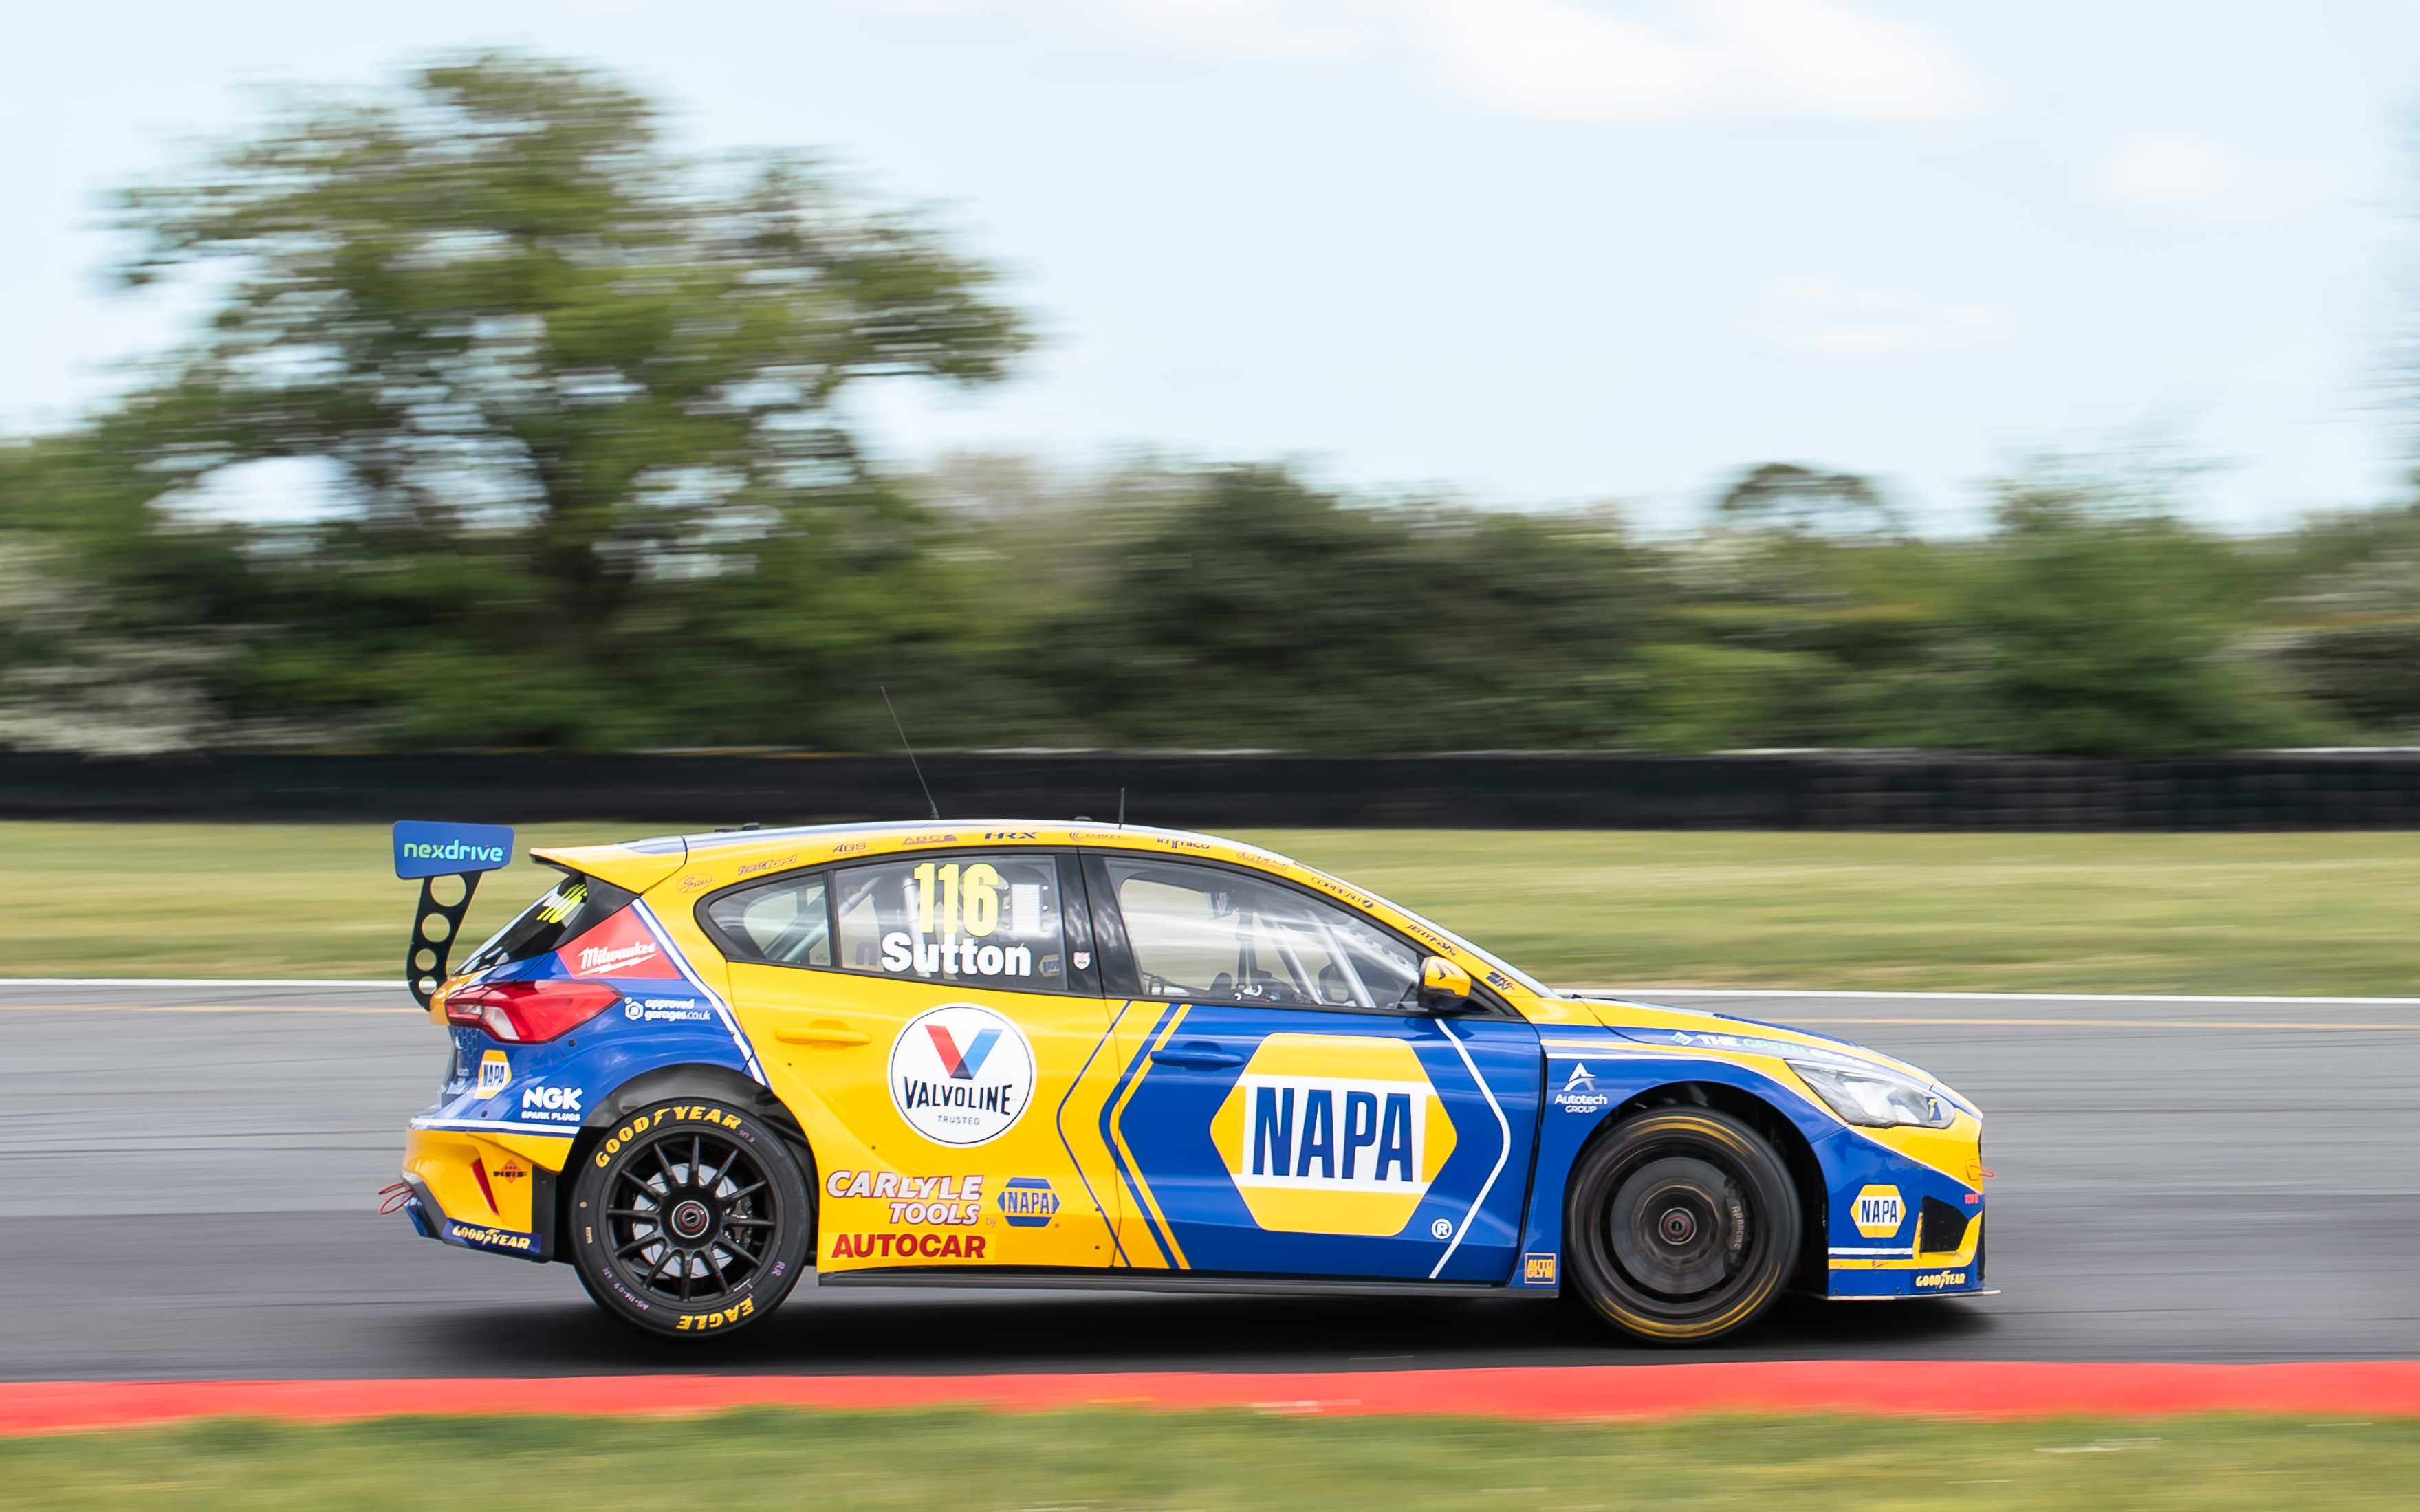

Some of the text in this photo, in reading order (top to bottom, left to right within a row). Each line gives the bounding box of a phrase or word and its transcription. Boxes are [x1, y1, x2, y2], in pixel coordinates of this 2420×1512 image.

[404, 838, 504, 862] nexdrive
[914, 863, 999, 936] 116
[577, 941, 657, 970] Milwaukee
[881, 932, 1032, 976] Sutton
[644, 998, 695, 1010] approved
[644, 1009, 711, 1022] garages.co.uk
[1696, 1034, 1741, 1047] THE
[481, 1064, 505, 1087] NAPA
[521, 1086, 584, 1111] NGK
[904, 1077, 1012, 1115] VALVOLINE
[1554, 1093, 1608, 1105] Autotech
[521, 1110, 581, 1122] SPARK PLUGS
[938, 1115, 980, 1125] TRUSTED
[1565, 1105, 1598, 1113] GROUP
[1252, 1086, 1413, 1182] NAPA
[826, 1170, 984, 1200] CARLYLE
[889, 1202, 997, 1227] TOOLS by
[1007, 1191, 1050, 1215] NAPA
[1862, 1200, 1897, 1223] NAPA
[831, 1233, 987, 1259] AUTOCAR
[771, 1260, 786, 1278] RR
[1527, 1259, 1553, 1269] AUTO
[676, 1297, 754, 1330] EAGLE
